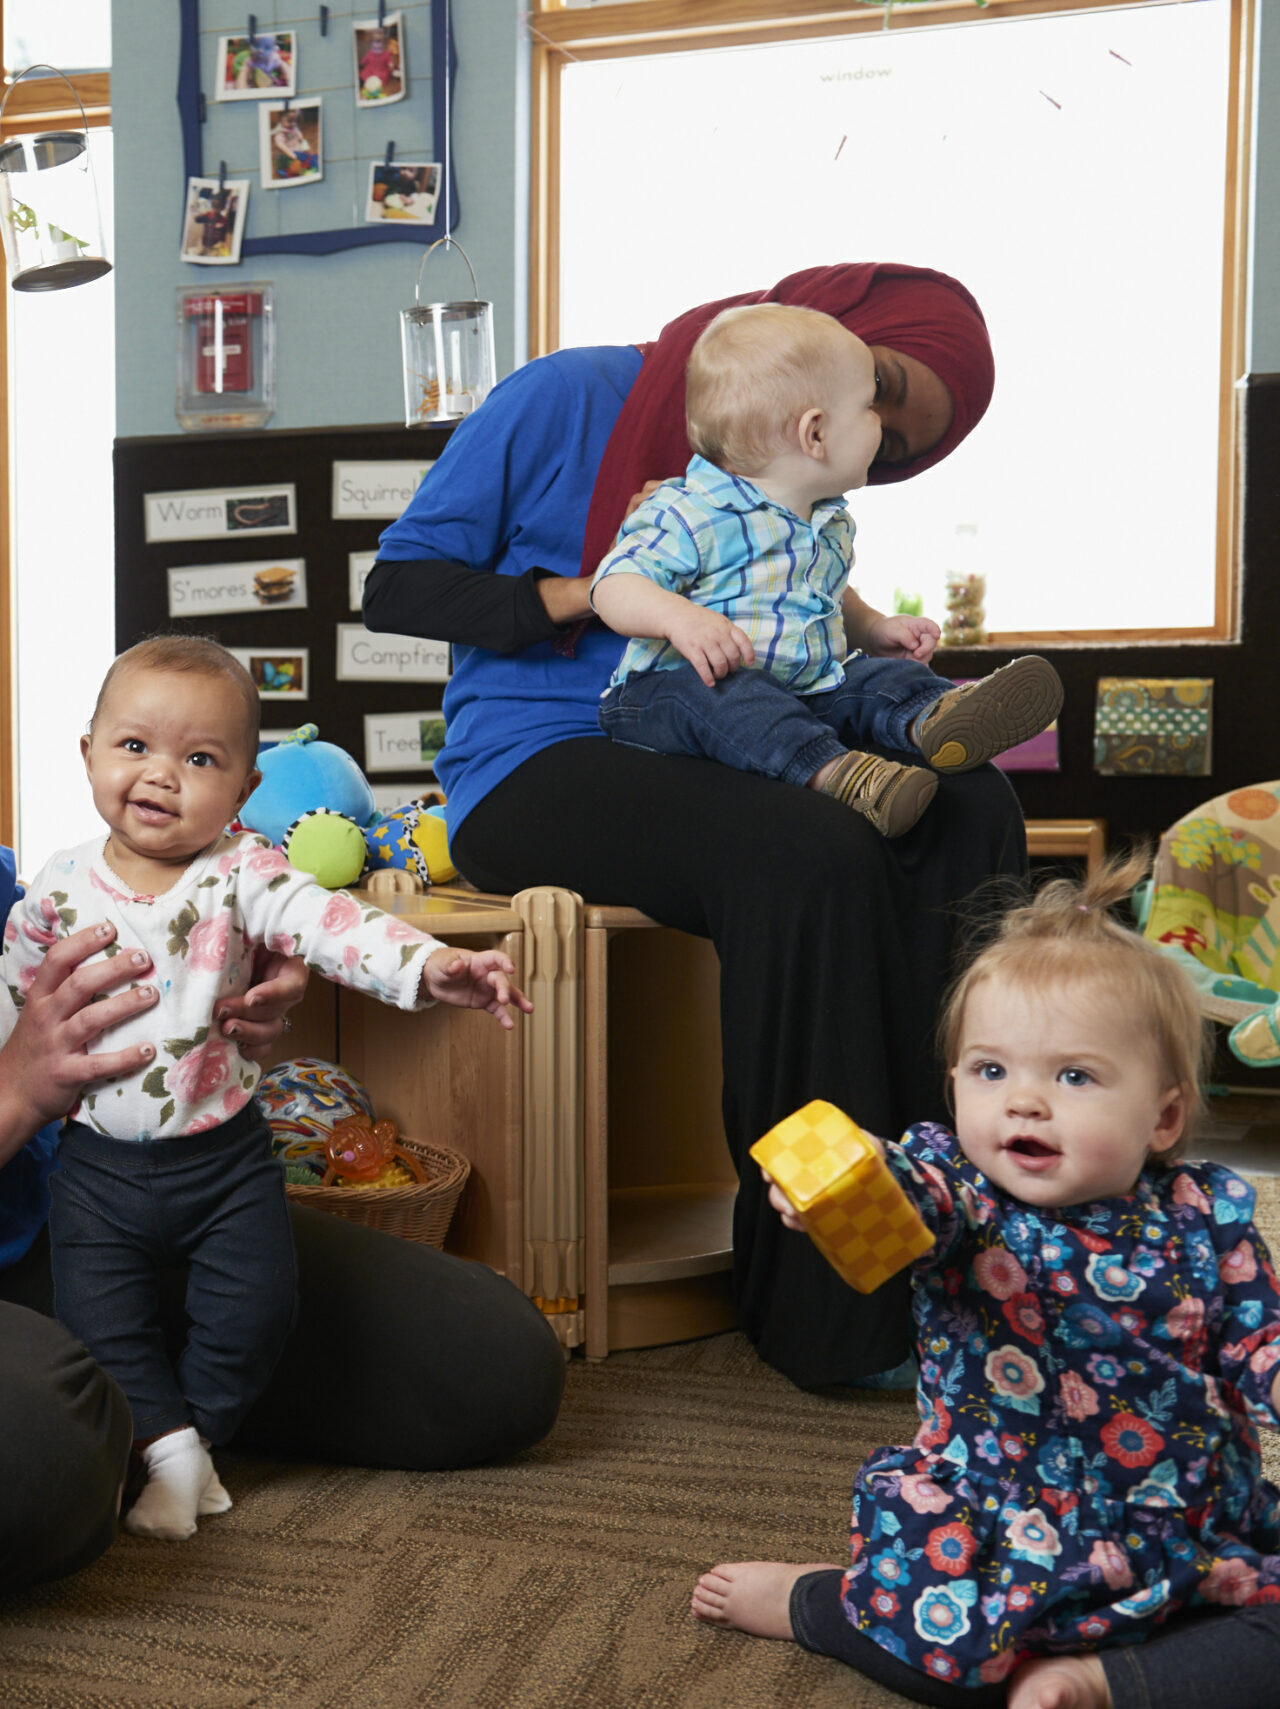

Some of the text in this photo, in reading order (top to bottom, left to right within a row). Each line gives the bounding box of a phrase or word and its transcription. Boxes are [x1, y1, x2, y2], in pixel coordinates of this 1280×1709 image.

[819, 65, 893, 82] window
[341, 478, 417, 510] Squirrel
[157, 501, 223, 522] Worm
[173, 580, 247, 602] S'mores
[351, 641, 447, 672] Campfire
[374, 729, 420, 752] Tree
